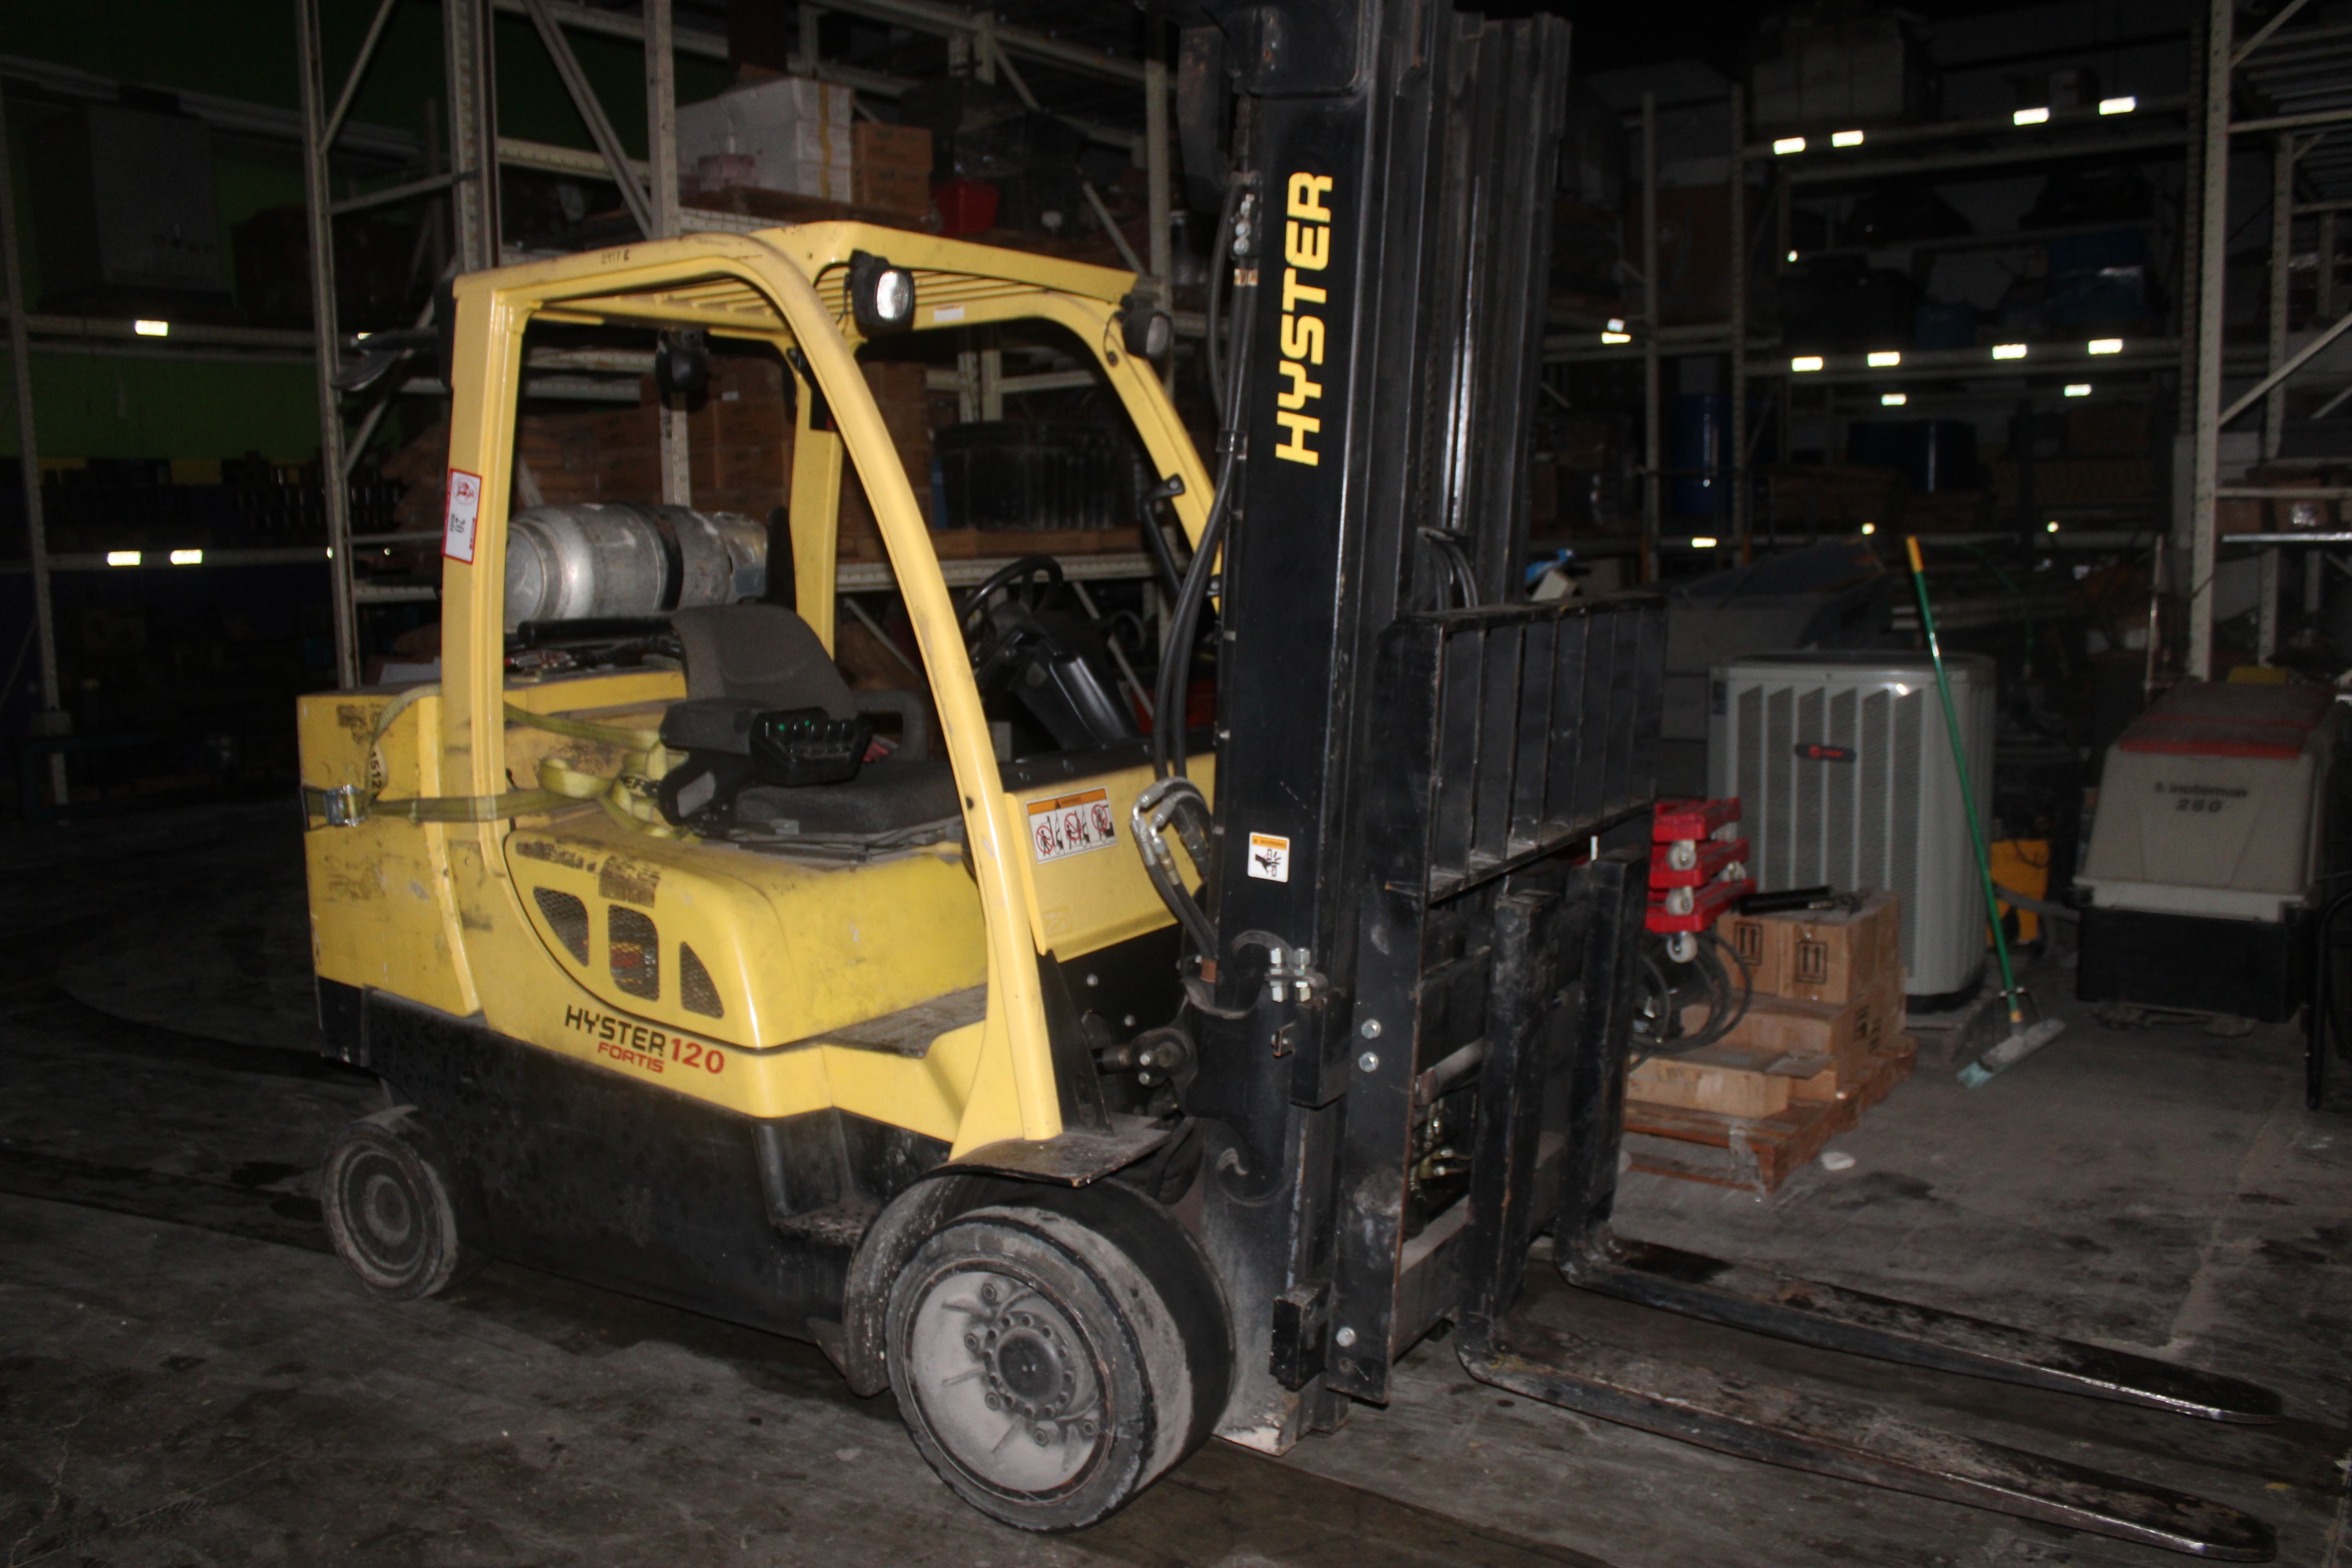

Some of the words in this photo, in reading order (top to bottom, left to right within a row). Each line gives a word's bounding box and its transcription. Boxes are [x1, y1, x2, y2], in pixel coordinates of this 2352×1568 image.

[1276, 172, 1333, 466] HYSTER
[2176, 798, 2223, 813] 260
[564, 1004, 666, 1055] HYSTER
[671, 1037, 724, 1074] 120
[597, 1041, 665, 1073] FORTIS
